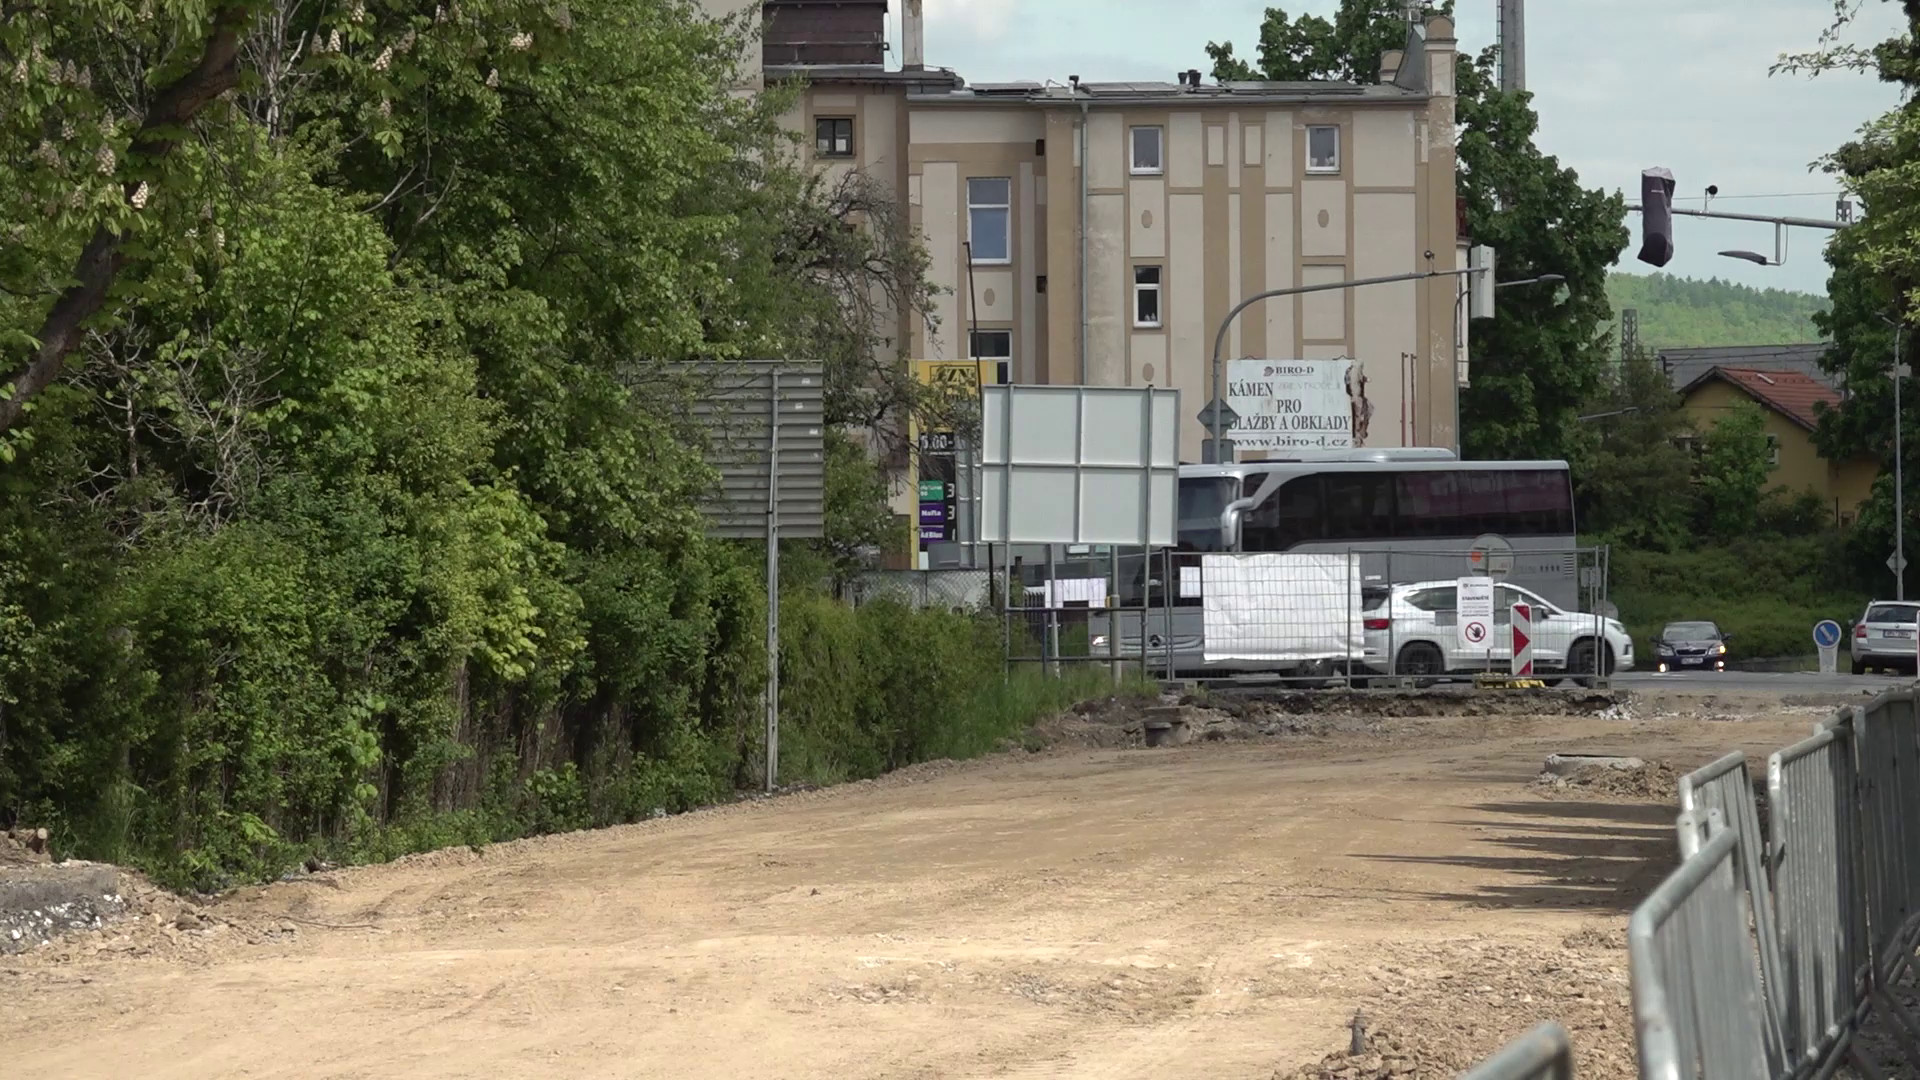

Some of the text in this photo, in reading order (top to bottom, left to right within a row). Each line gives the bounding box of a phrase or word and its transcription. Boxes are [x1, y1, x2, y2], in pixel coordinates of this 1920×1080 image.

[1275, 366, 1314, 374] BIRO-D
[1229, 379, 1274, 396] KÁMEN
[1276, 399, 1302, 413] PRO
[1279, 416, 1289, 430] A
[1291, 415, 1351, 430] OBKLADY
[1232, 436, 1348, 447] www.biro-d.cz
